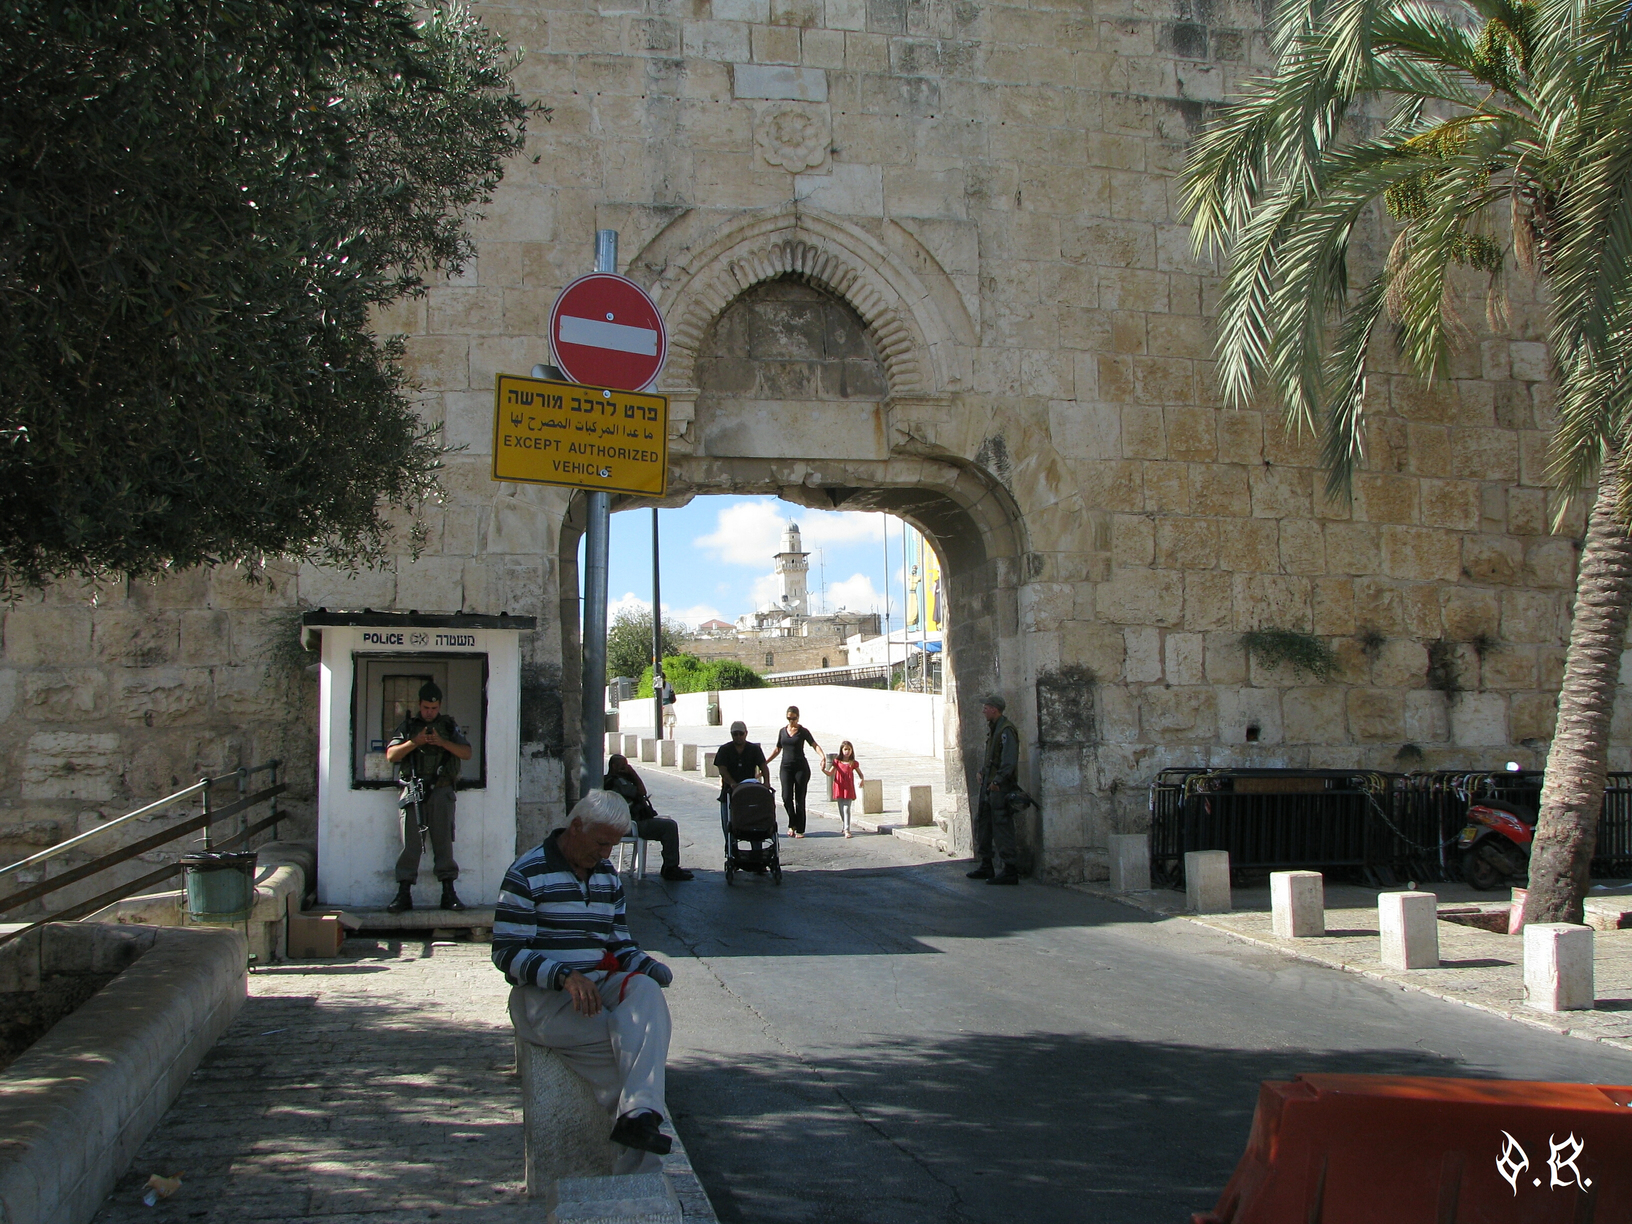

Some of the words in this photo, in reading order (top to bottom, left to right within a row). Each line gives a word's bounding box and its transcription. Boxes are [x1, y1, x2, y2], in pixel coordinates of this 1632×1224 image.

[508, 389, 563, 409] מורשה
[570, 396, 617, 416] לרכב
[510, 411, 524, 428] لها
[624, 404, 658, 422] פרט
[527, 416, 571, 432] المصرح
[575, 421, 619, 439] المركبات
[623, 425, 639, 439] عدا
[643, 428, 654, 440] ما
[503, 434, 562, 452] EXCEPT
[568, 442, 659, 463] AUTHORIZED
[552, 460, 613, 478] VEHICLE
[435, 634, 475, 647] משטרה
